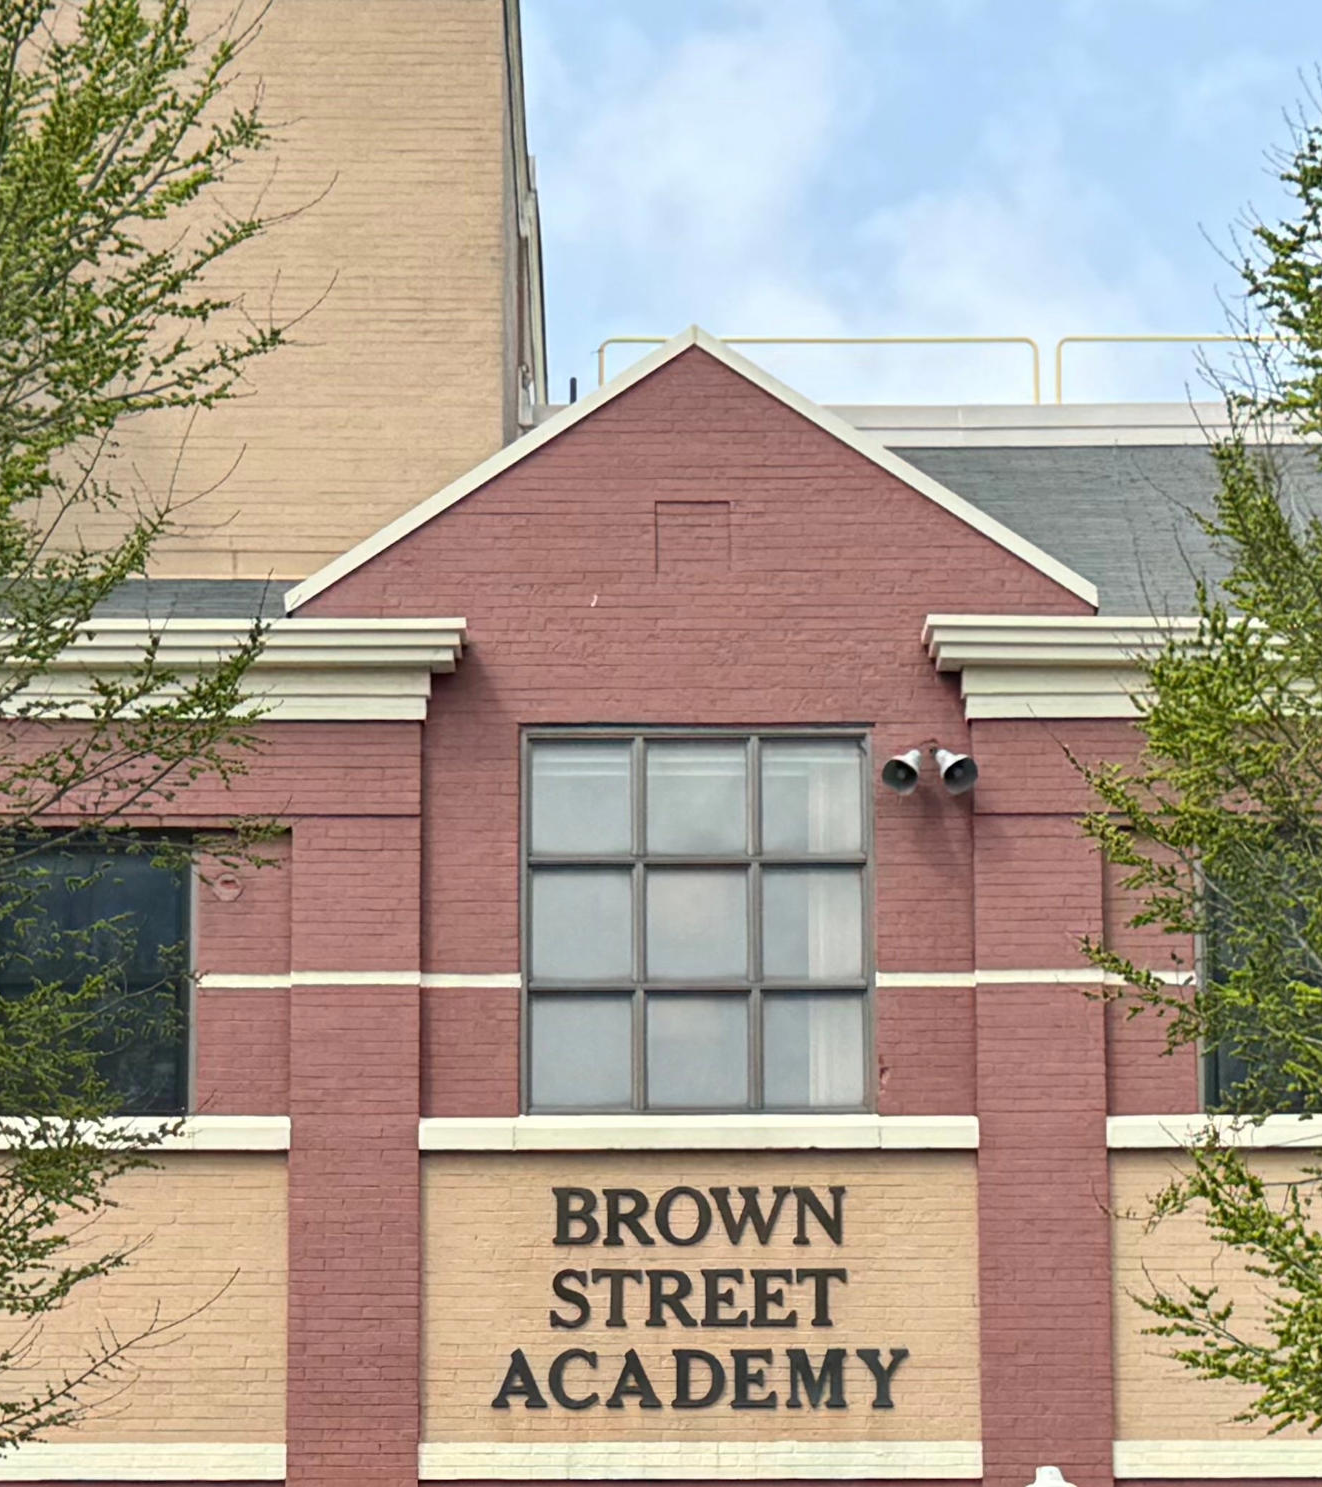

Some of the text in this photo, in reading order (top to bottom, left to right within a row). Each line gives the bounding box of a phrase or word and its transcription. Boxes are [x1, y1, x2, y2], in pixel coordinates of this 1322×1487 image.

[552, 1186, 845, 1246] BROWN
[550, 1268, 846, 1327] STREET
[491, 1348, 909, 1409] ACADEMY
